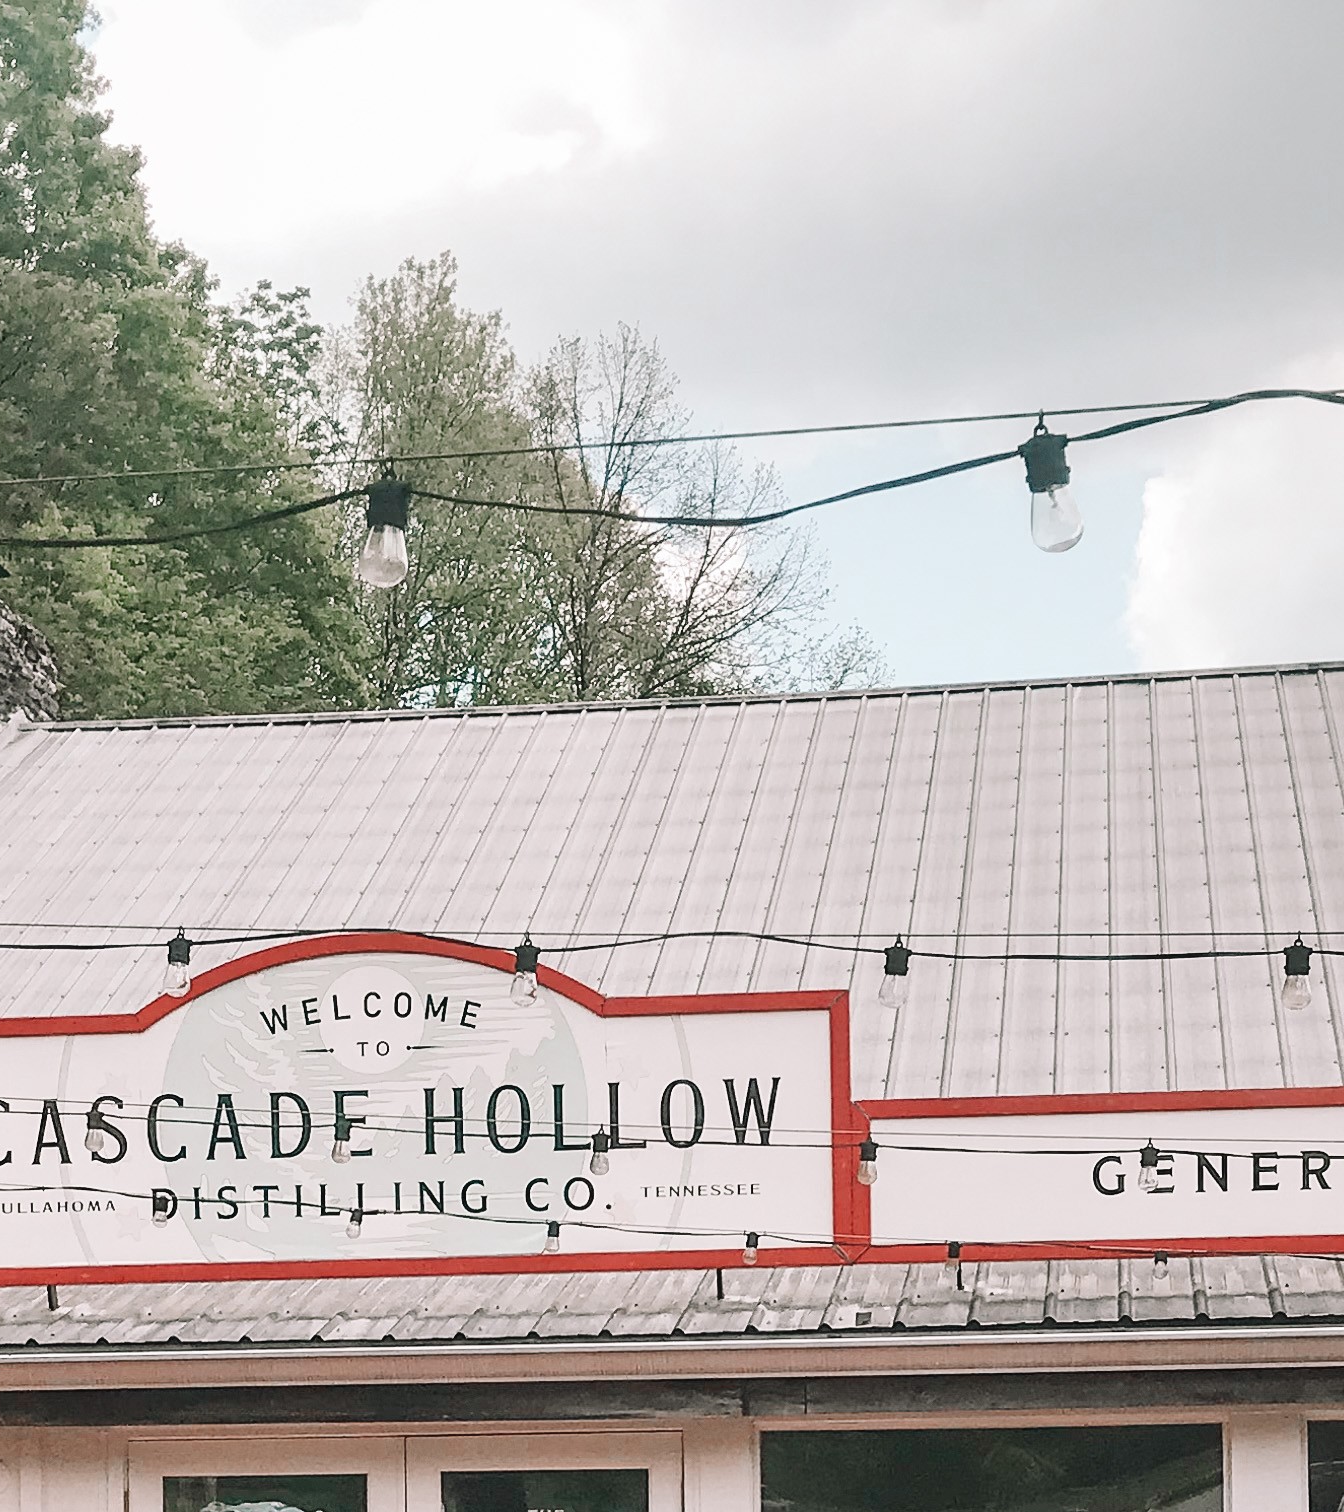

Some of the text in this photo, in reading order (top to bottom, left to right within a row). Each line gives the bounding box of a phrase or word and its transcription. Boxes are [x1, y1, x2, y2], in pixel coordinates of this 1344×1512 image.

[259, 991, 482, 1035] WELCOME
[356, 1040, 390, 1057] TO
[423, 1075, 782, 1156] HOLLOW
[150, 1176, 612, 1221] DISTILLING CO.
[640, 1183, 762, 1198] TENNESSEE
